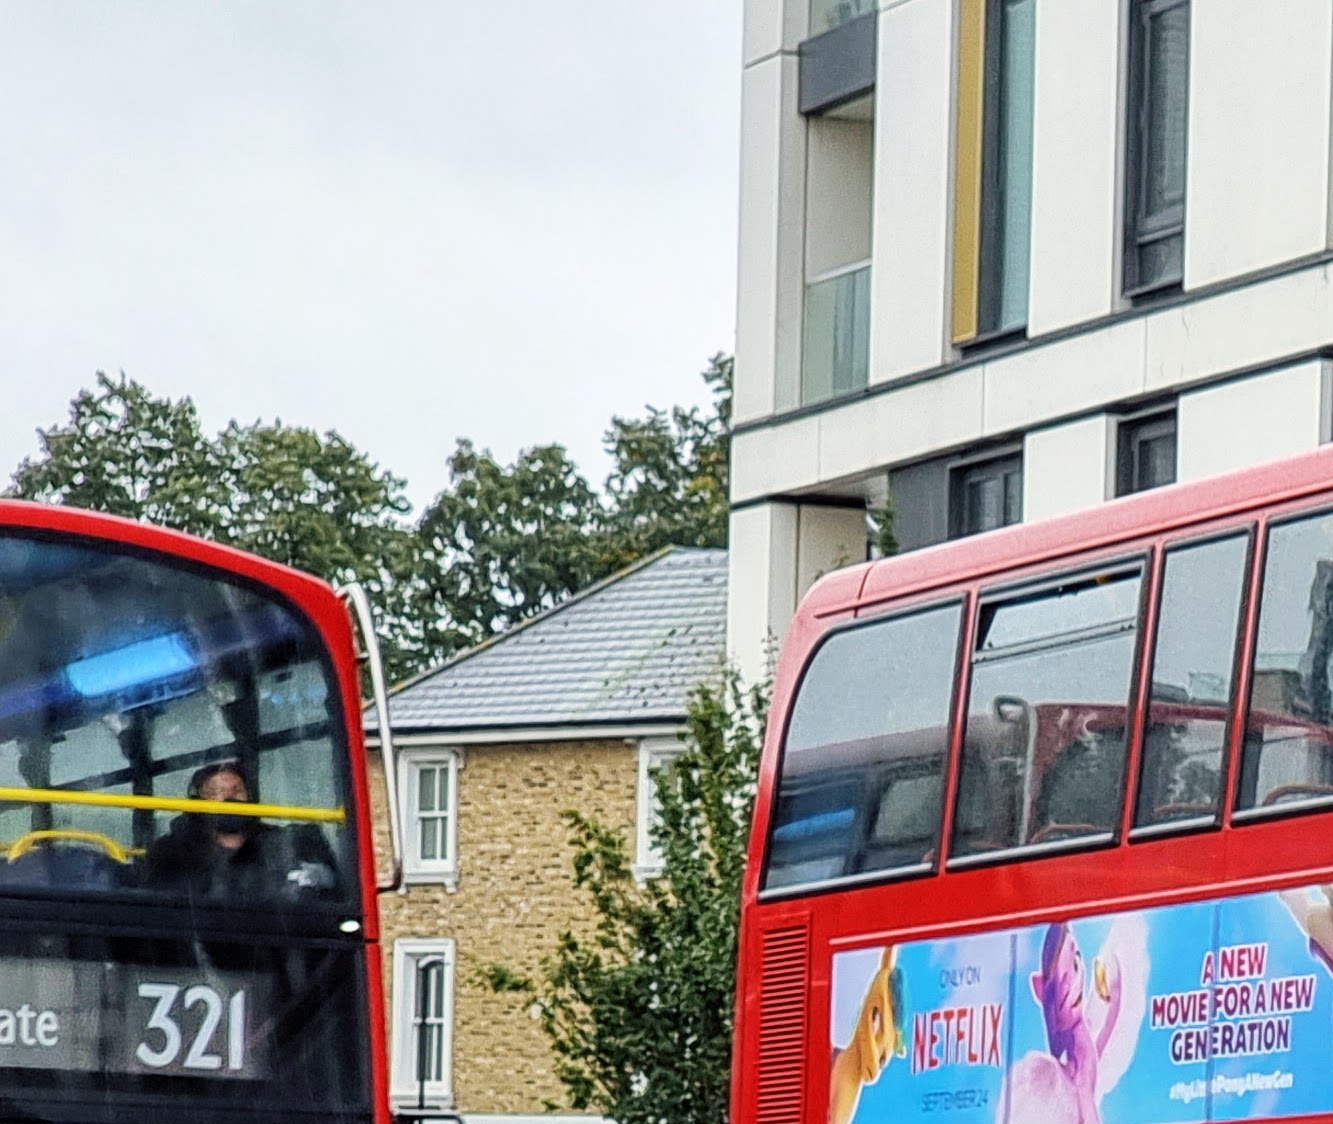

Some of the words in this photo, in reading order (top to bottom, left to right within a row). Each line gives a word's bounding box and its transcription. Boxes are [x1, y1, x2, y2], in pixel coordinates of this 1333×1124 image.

[1202, 954, 1214, 985] A
[1220, 945, 1266, 980] NEW
[0, 1003, 60, 1047] ate
[1151, 992, 1208, 1028] MOVIE
[1212, 985, 1251, 1018] FOR
[1254, 983, 1268, 1014] A
[1270, 977, 1315, 1013] NEW
[136, 983, 246, 1071] 321
[912, 1003, 1003, 1076] NETFLIX
[1171, 1018, 1291, 1063] GENERATION
